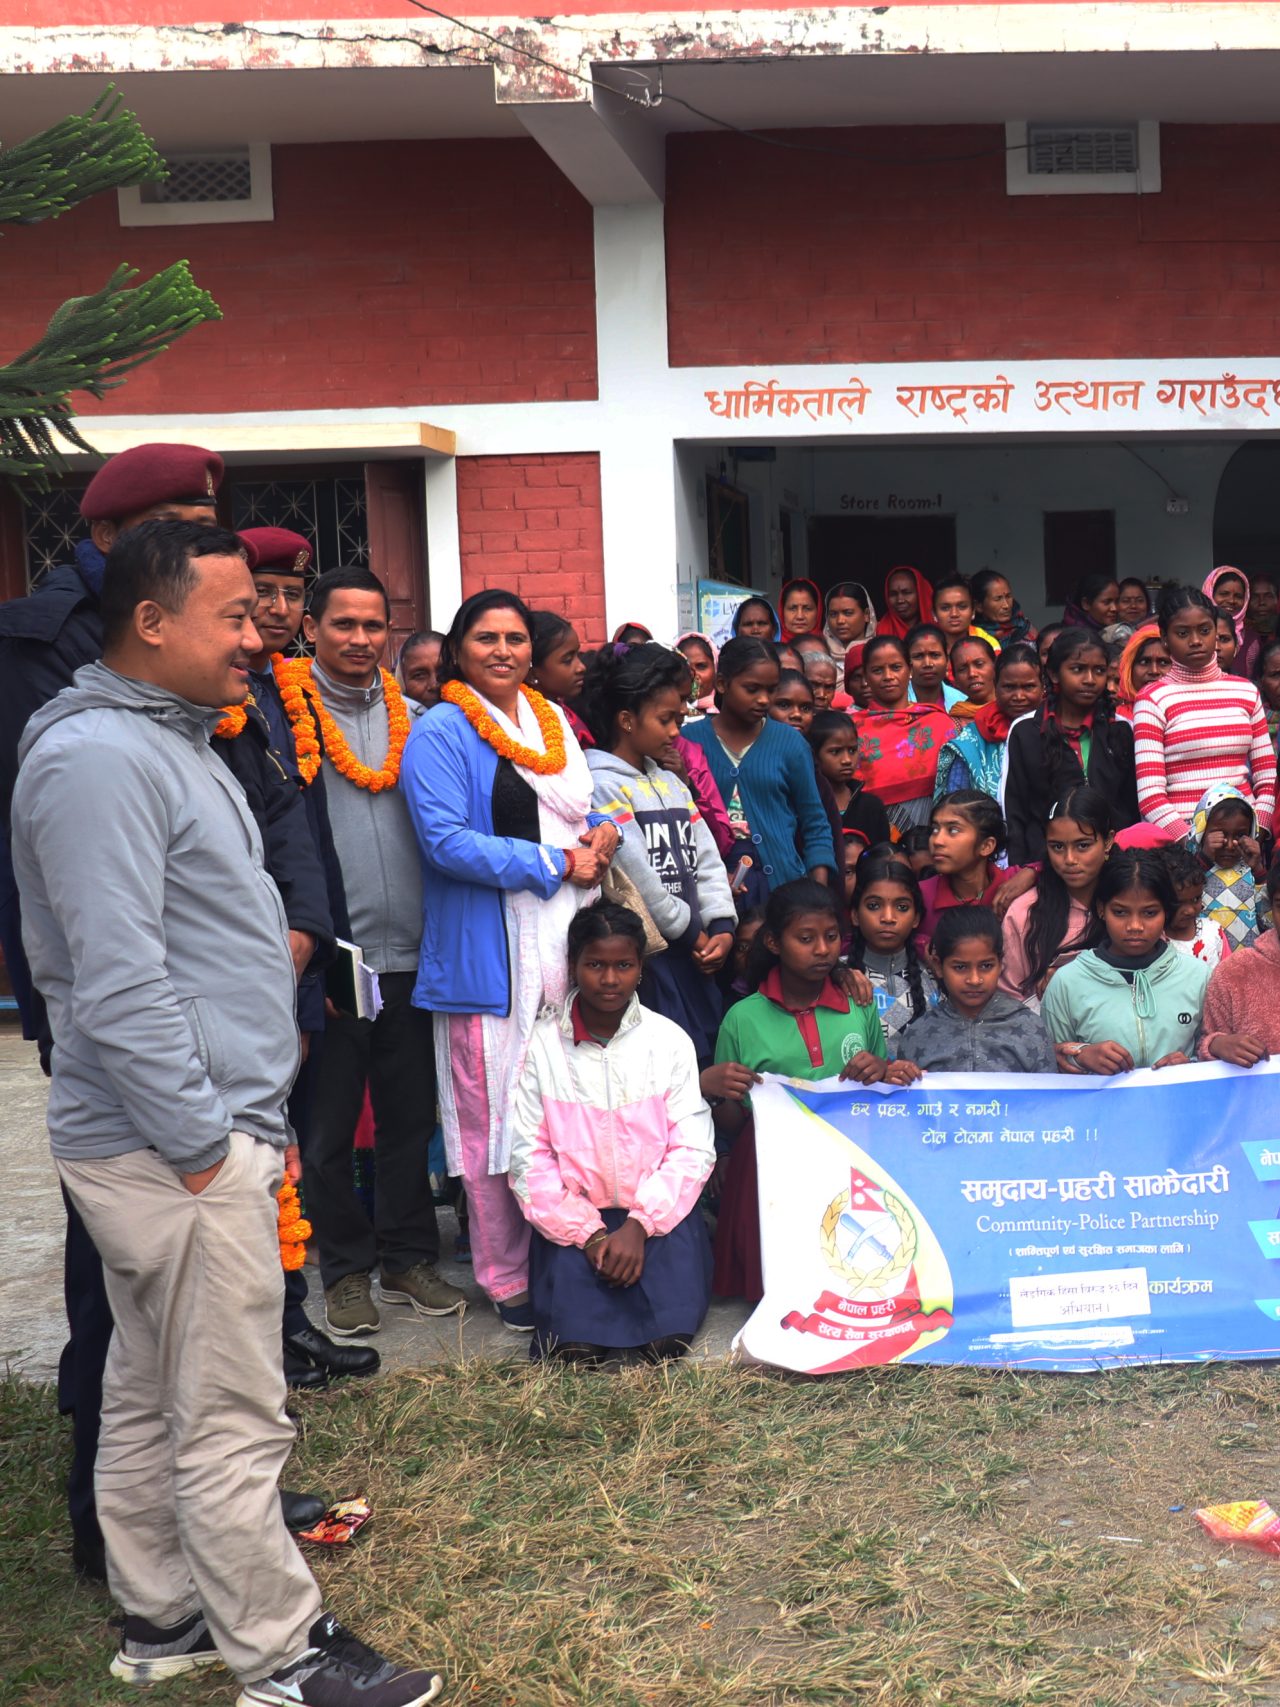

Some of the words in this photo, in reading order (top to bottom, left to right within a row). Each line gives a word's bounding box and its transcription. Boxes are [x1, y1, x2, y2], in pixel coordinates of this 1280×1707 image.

[704, 377, 872, 422] धार्मिकताले
[896, 375, 1015, 424] राष्ट्रको
[1034, 379, 1145, 416] उत्थान
[840, 494, 880, 510] Store
[851, 1102, 870, 1116] हर
[949, 1103, 959, 1117] र
[921, 1128, 947, 1145] टोल
[954, 1128, 993, 1145] टोलमा
[1000, 1127, 1035, 1144] नेपाल
[1041, 1125, 1075, 1145] प्रहरी
[1123, 1164, 1230, 1199] साझेदारी
[976, 1213, 1126, 1236] Community-Police
[1130, 1209, 1219, 1230] Partnership
[1149, 1277, 1213, 1295] कार्यक्रम
[838, 1299, 867, 1315] नेपाल
[870, 1299, 896, 1316] प्रहरी
